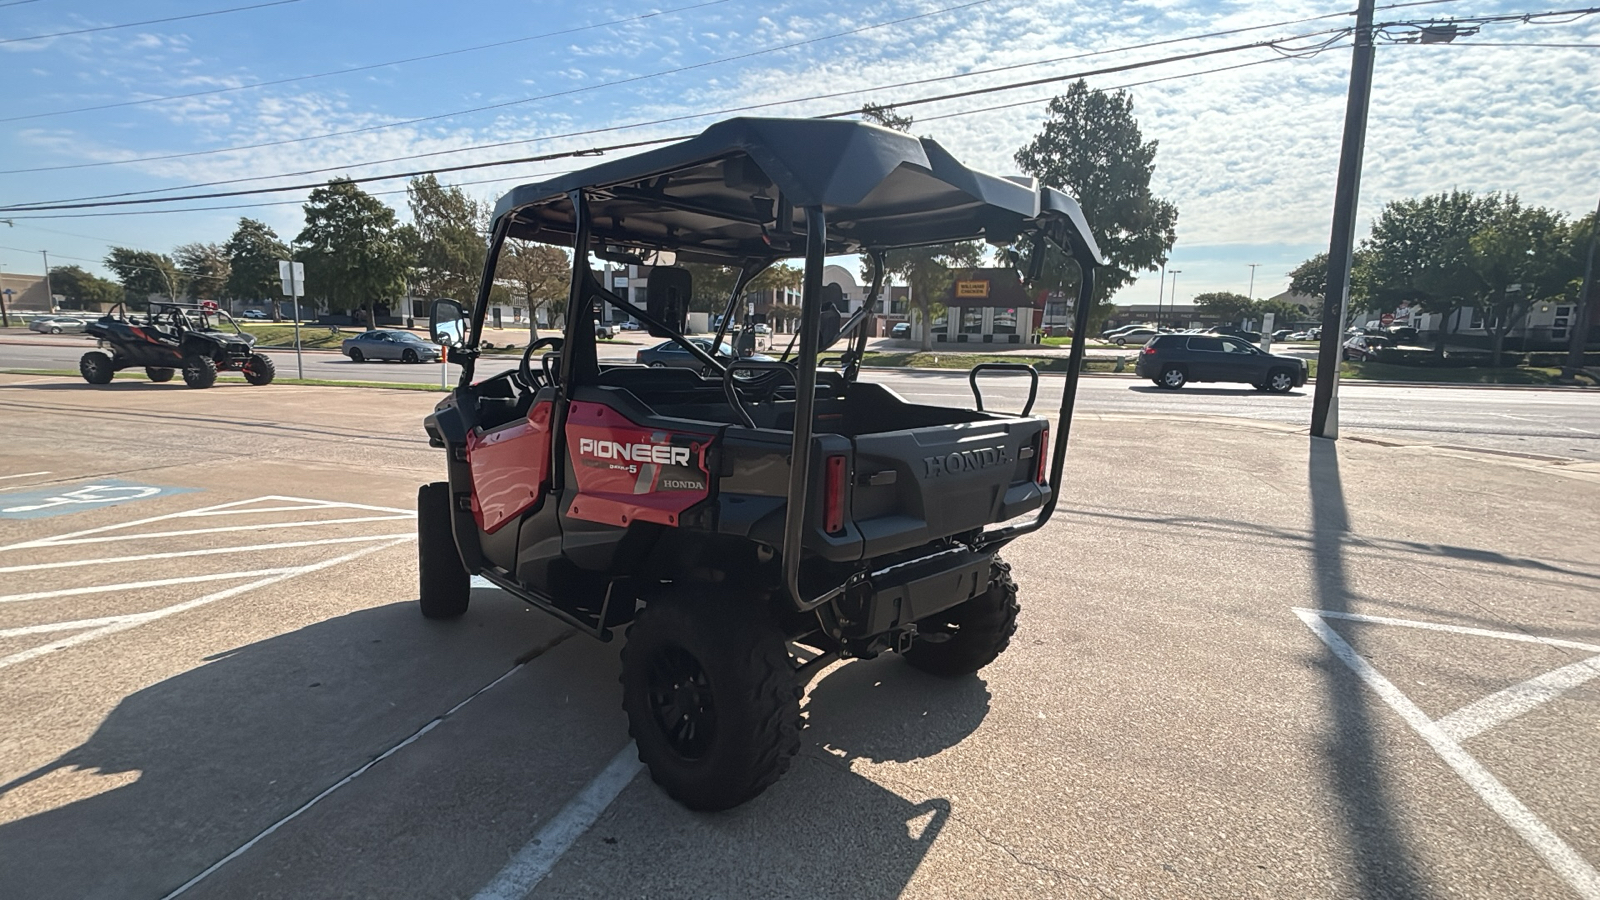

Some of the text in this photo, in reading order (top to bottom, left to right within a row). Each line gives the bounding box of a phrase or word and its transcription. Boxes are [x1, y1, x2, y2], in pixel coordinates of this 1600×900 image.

[579, 438, 690, 467] PIONEER
[923, 445, 1008, 479] HONDA
[663, 480, 704, 490] HONDA
